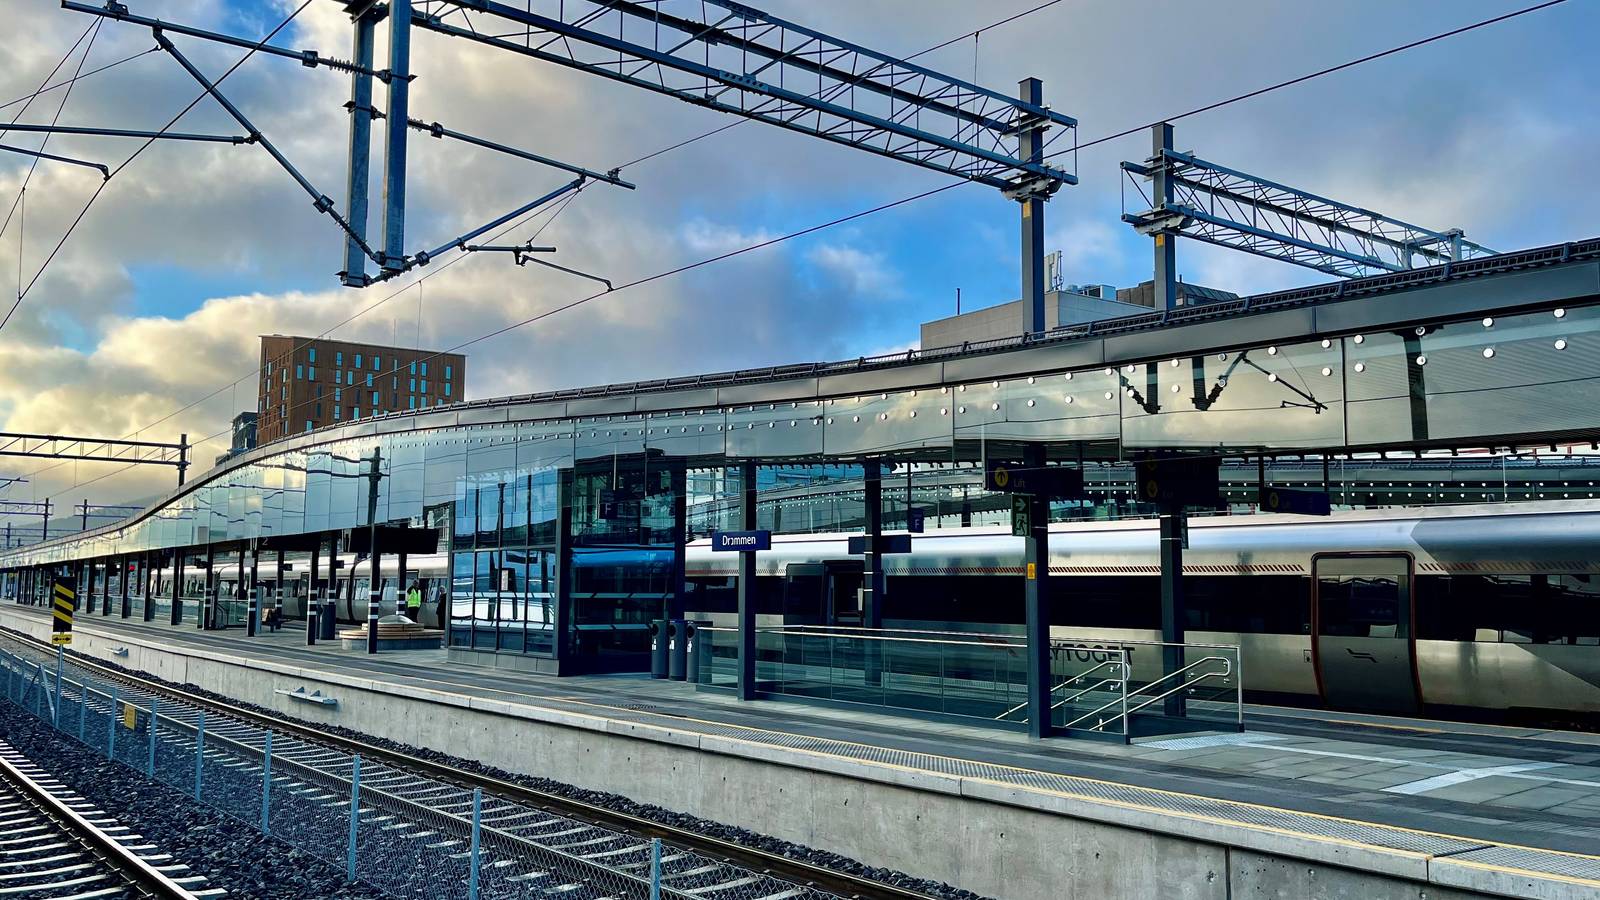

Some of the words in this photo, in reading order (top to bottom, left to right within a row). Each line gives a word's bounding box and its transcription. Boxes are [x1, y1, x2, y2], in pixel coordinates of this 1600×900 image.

[914, 518, 921, 529] F
[722, 535, 757, 547] Drammen
[1049, 643, 1136, 667] YTOGET
